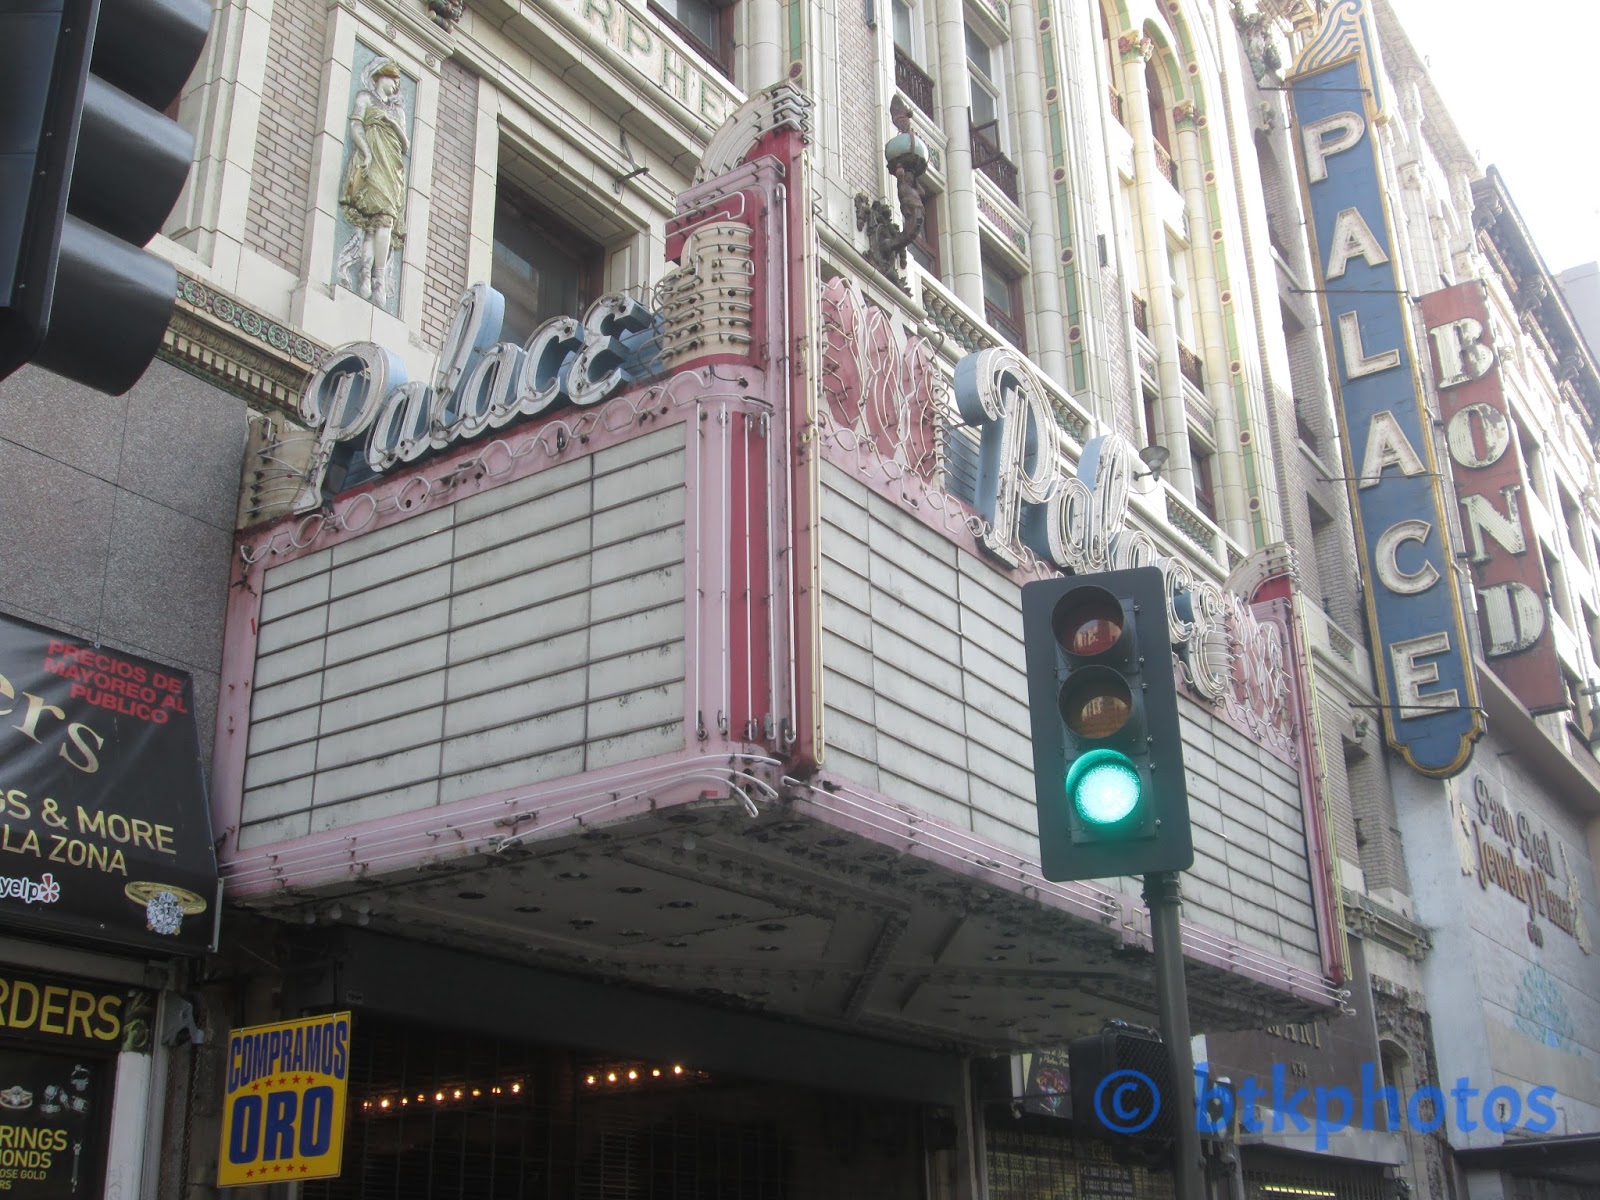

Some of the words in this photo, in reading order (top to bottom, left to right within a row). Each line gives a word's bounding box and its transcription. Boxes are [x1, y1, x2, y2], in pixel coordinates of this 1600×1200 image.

[295, 281, 652, 514] Palace
[1302, 111, 1461, 719] PALACE
[1429, 317, 1545, 656] BOND
[44, 657, 156, 703] MAYOREO
[161, 695, 188, 714] AL
[48, 640, 147, 683] PRECIOS
[152, 672, 183, 694] DE
[70, 683, 169, 724] PUBLICO
[2, 823, 42, 858] LA
[49, 834, 128, 877] ZONA
[41, 798, 70, 830] &
[77, 805, 177, 855] MORE
[0, 876, 40, 903] yelp
[228, 1020, 348, 1094] COMPRAMOS
[229, 1086, 335, 1165] ORO
[0, 1149, 52, 1169] ONDS
[20, 1171, 47, 1180] GOLD
